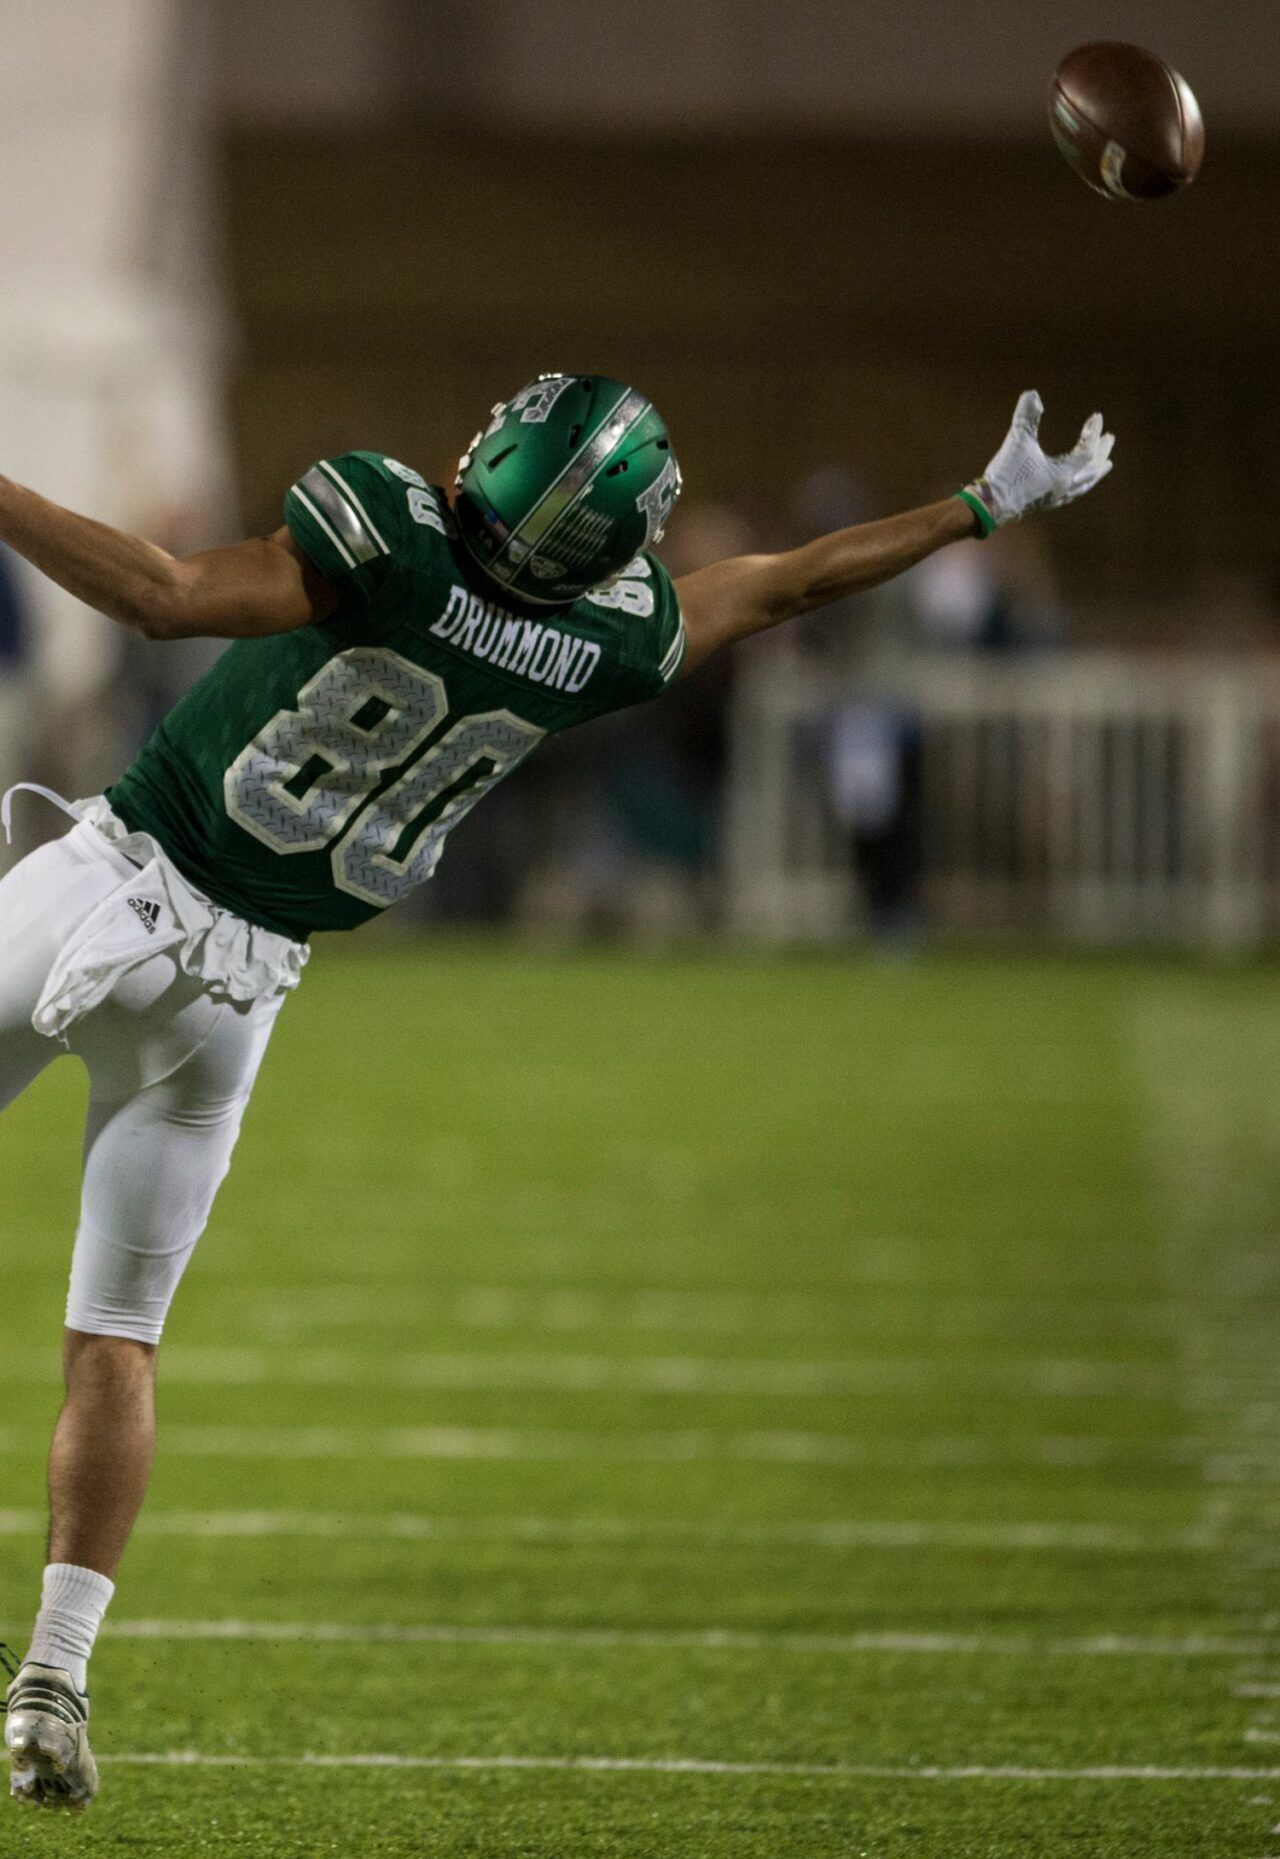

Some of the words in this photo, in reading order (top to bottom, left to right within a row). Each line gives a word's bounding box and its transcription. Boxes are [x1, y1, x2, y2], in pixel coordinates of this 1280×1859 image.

[429, 584, 601, 692] DRUMMOND
[223, 647, 549, 909] 80
[127, 898, 156, 934] adidas
